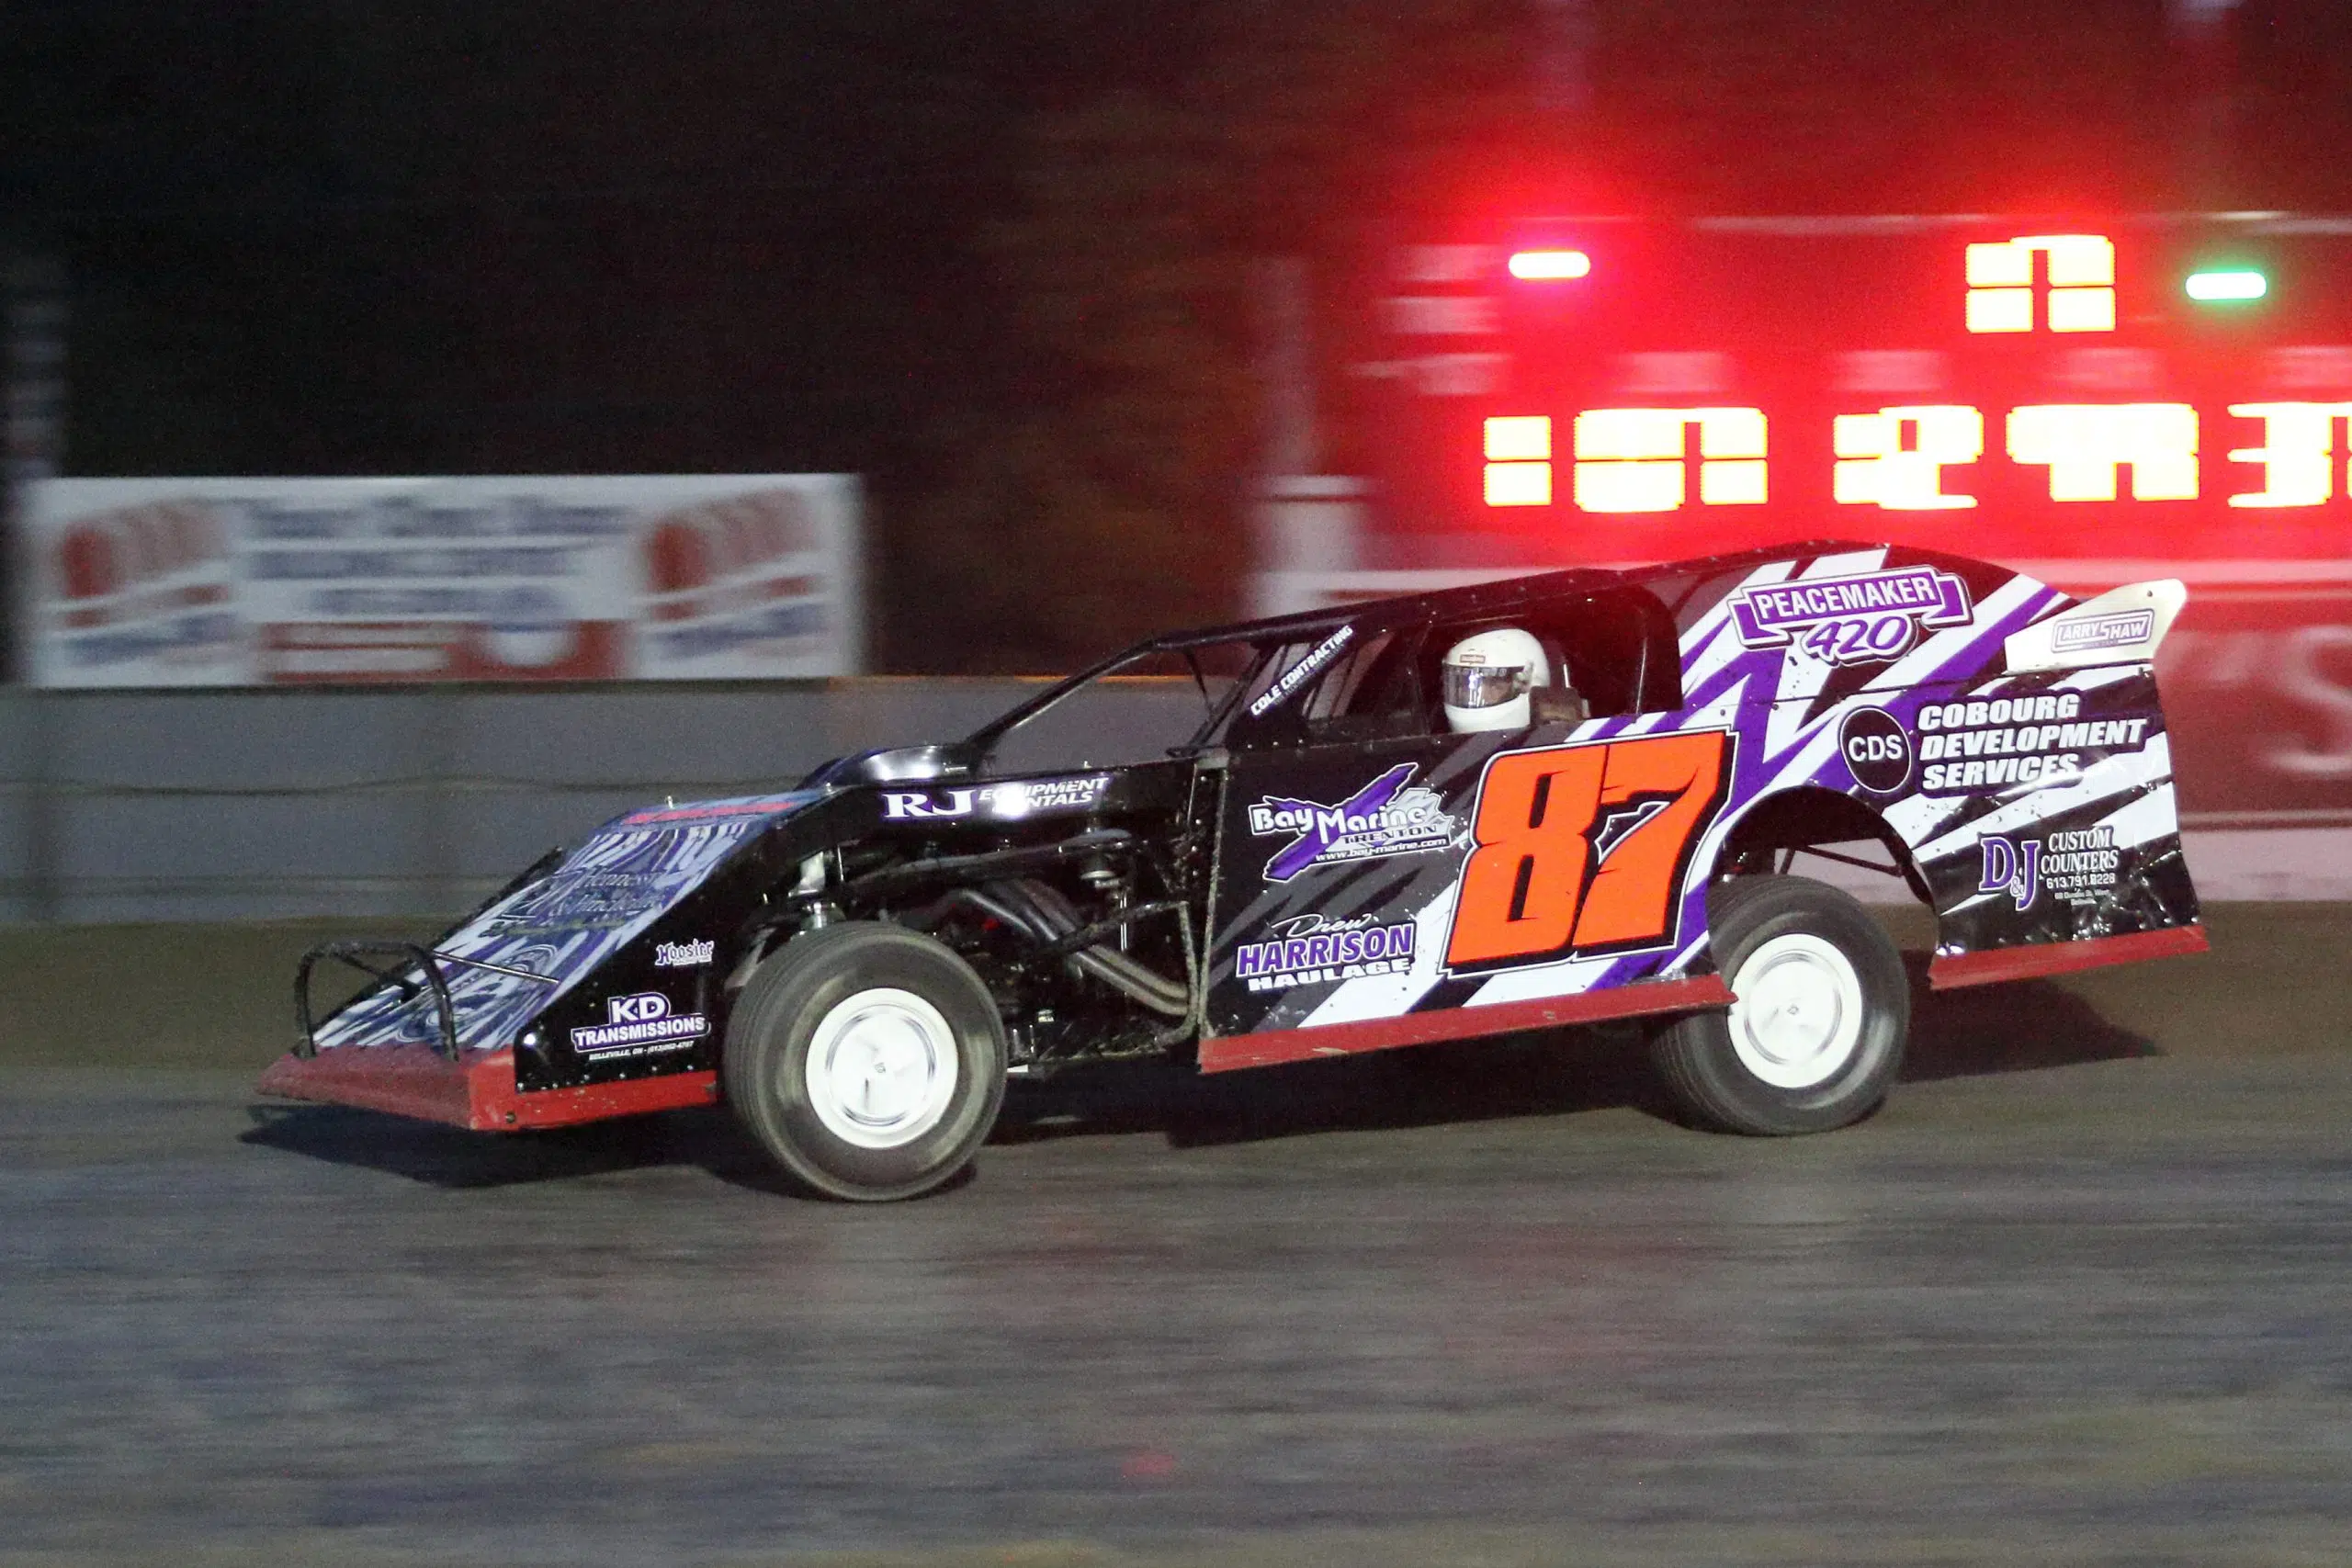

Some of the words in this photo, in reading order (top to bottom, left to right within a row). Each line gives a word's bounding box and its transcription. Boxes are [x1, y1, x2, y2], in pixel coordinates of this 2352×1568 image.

[1754, 576, 1937, 620] PEACEMAKER
[1805, 615, 1908, 657] 420
[1250, 684, 1283, 716] COLE
[1280, 625, 1353, 690] CONTRACTING
[1917, 694, 2081, 731] COBOURG
[1848, 734, 1904, 762] CDS
[1918, 718, 2148, 761] DEVELOPMENT
[1922, 752, 2080, 790] SERVICES
[882, 789, 978, 818] RJ
[1344, 823, 1439, 844] TRENTON
[1446, 730, 1726, 966] 87
[2048, 827, 2111, 852] CUSTOM
[1315, 838, 1448, 862] www.bay-marine.com
[2041, 850, 2119, 874] COUNTERS
[1272, 913, 1373, 937] Drew
[654, 938, 715, 965] Hoosier
[1236, 922, 1416, 978] HARRISON
[1248, 957, 1412, 992] HAULAGE
[611, 994, 667, 1023] KD
[574, 1017, 707, 1046] TRANSMISSIONS
